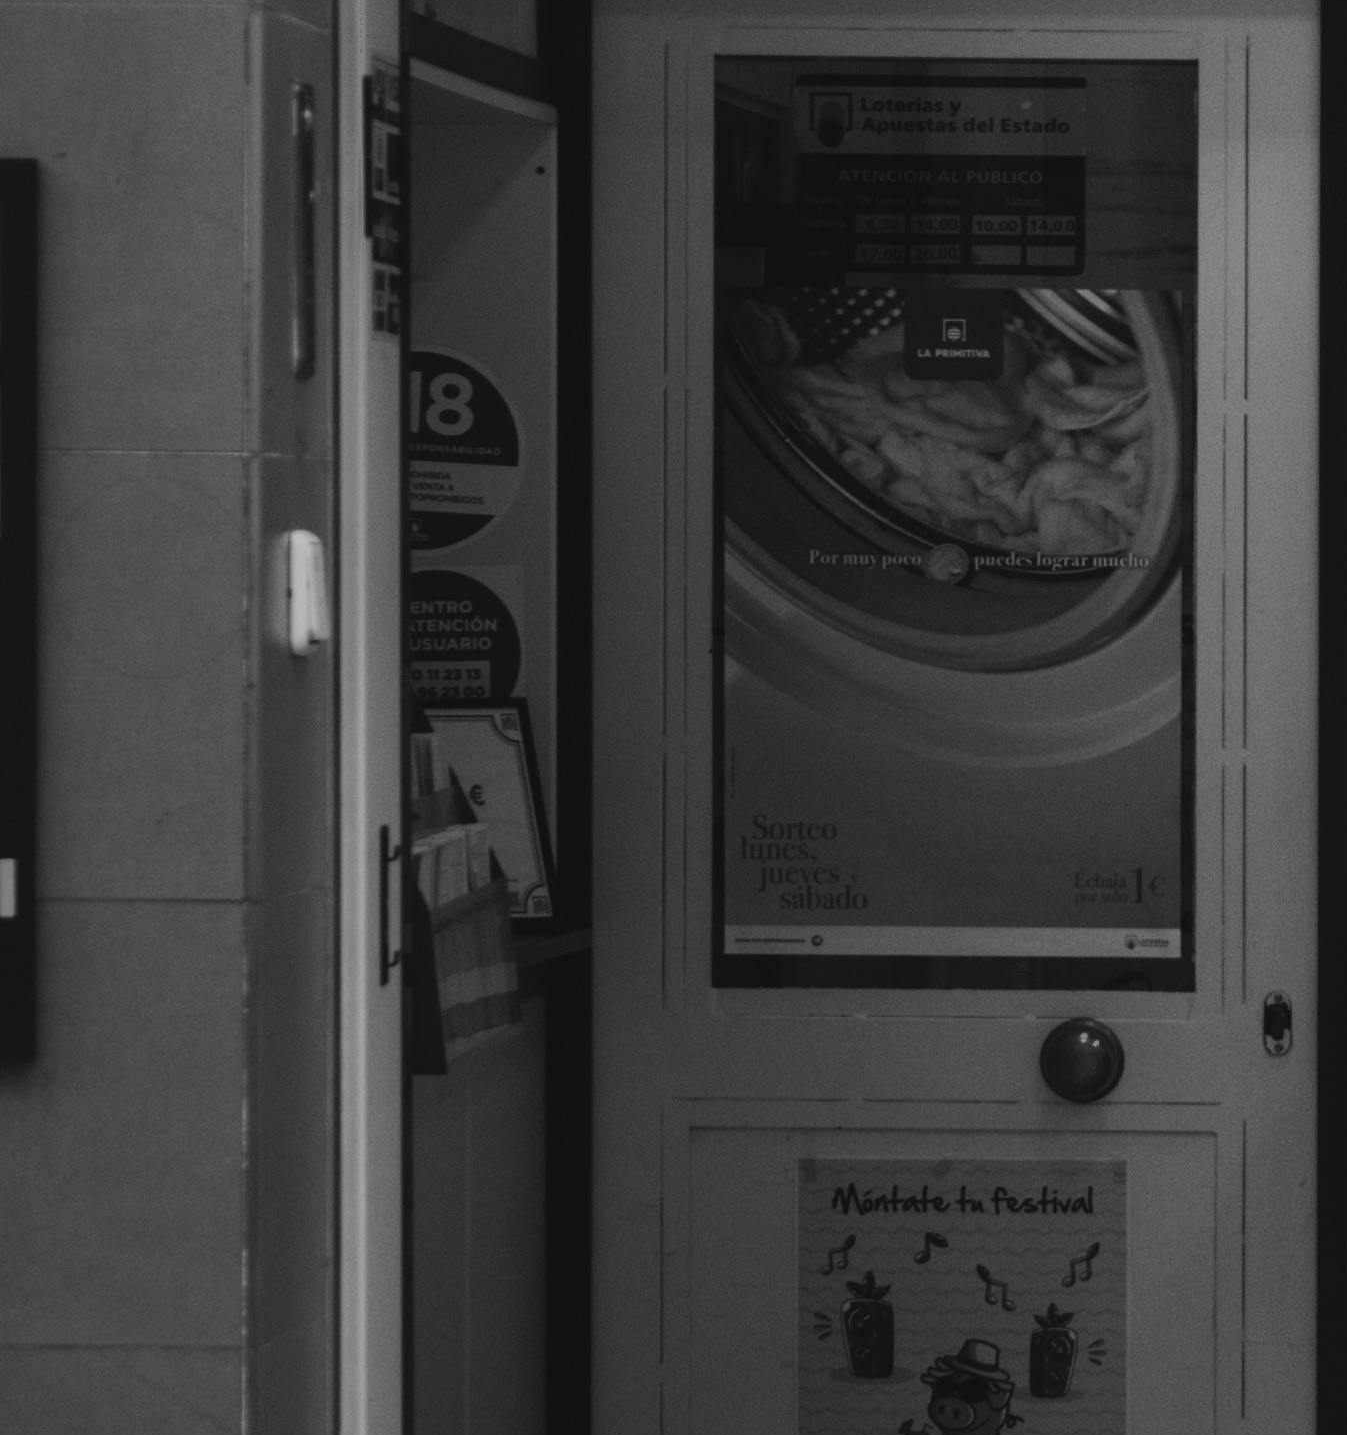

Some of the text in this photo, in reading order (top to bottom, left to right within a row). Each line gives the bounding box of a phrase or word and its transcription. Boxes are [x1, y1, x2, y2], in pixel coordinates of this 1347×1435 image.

[862, 117, 1071, 135] Apuestas del Estado
[917, 349, 992, 359] LA PRIMITIVA
[808, 549, 1151, 571] Por muy poco puedes lograr mucho
[409, 600, 473, 615] ENTRO
[751, 815, 839, 842] Sorteo
[740, 834, 818, 862] lunes,
[758, 865, 841, 893] jueves
[779, 884, 869, 911] sábado
[830, 1182, 1096, 1217] Móntate tu festival
